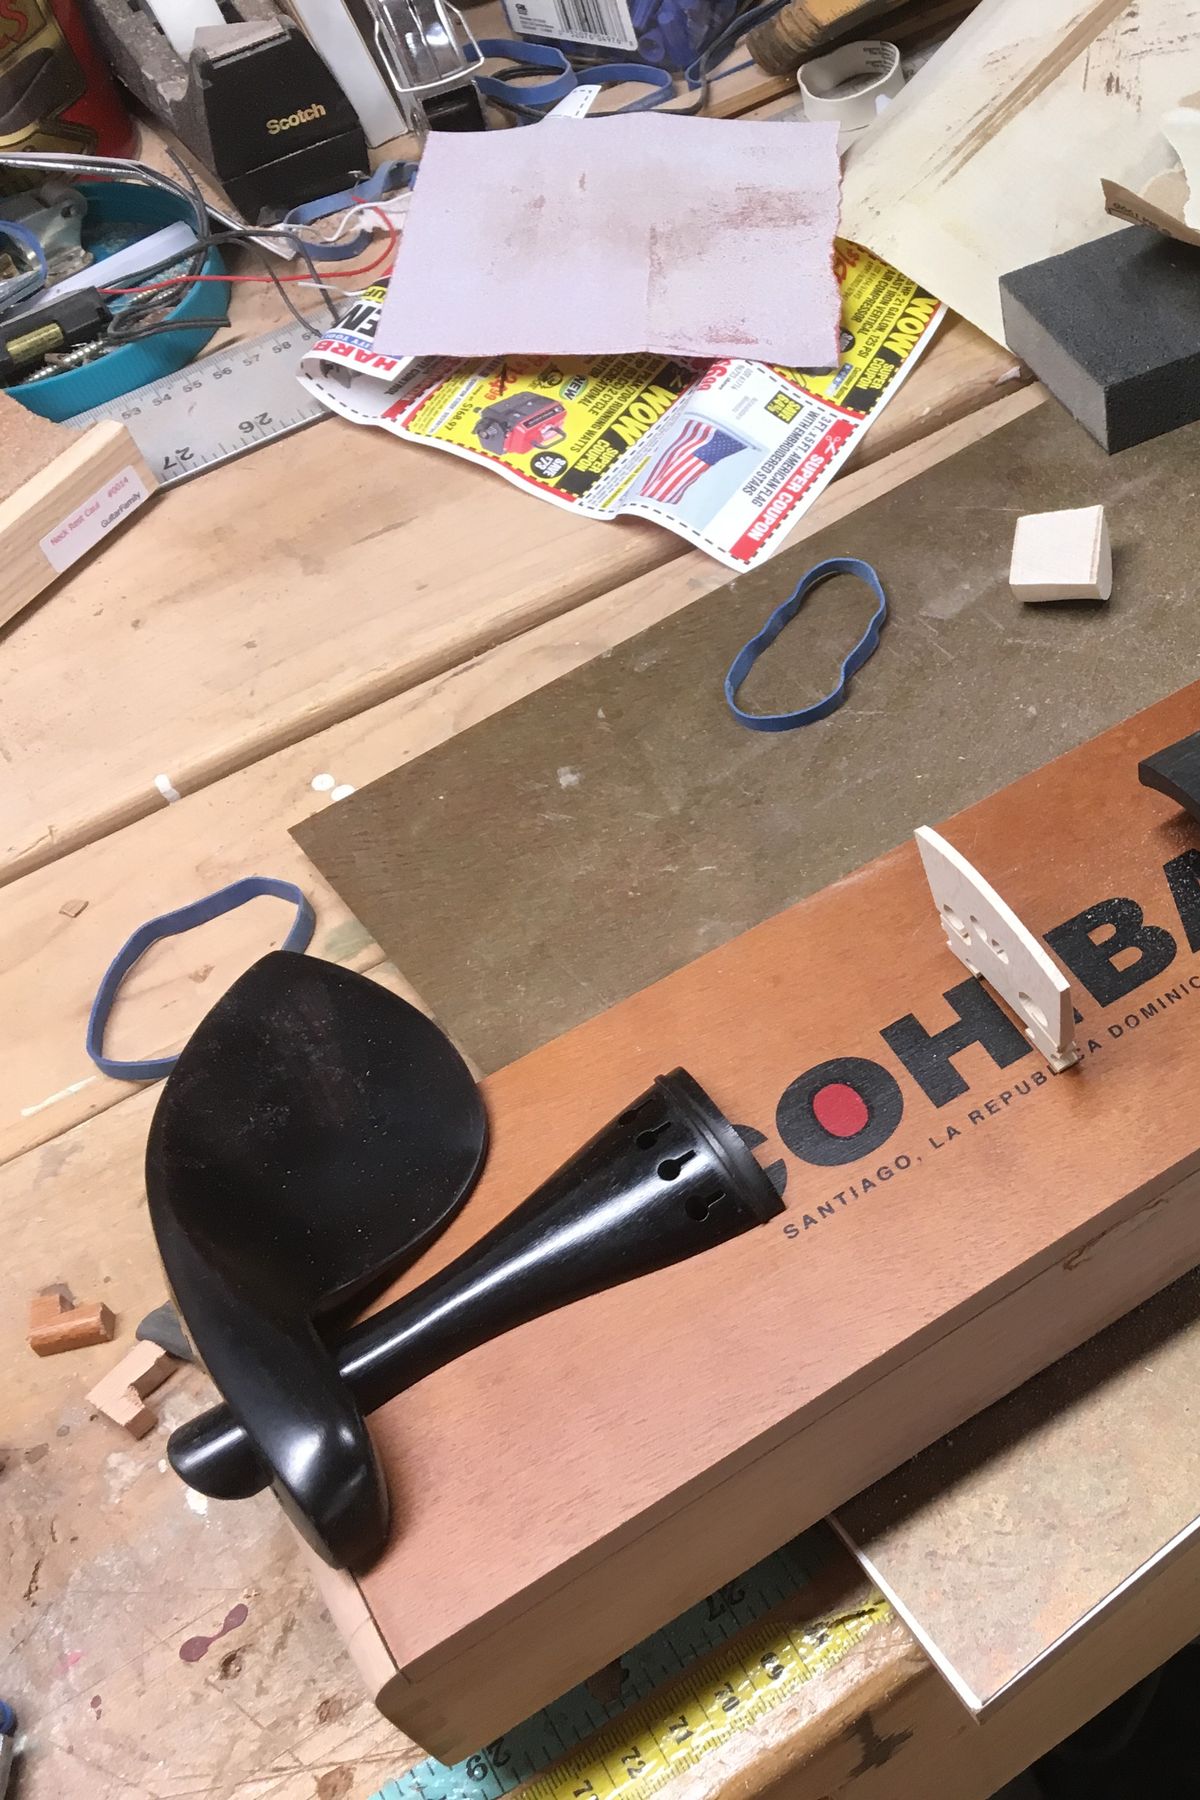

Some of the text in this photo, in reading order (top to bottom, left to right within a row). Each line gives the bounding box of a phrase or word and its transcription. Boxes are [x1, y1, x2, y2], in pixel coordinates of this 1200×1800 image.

[266, 103, 326, 135] Scotch
[851, 269, 896, 323] AIR COMPRESSOR
[879, 290, 895, 306] IRON
[857, 304, 883, 336] VERTICAL
[884, 298, 939, 358] WOW
[857, 345, 872, 359] PSI
[865, 333, 879, 346] 125
[122, 407, 142, 421] 53
[152, 393, 172, 407] 54
[182, 380, 203, 393] 55
[212, 367, 233, 380] 56
[242, 354, 261, 367] 57
[272, 341, 292, 354] 58
[384, 367, 420, 395] CONTROL
[564, 375, 587, 400] NEW
[577, 359, 627, 408] RECREATIONAL
[856, 358, 885, 390] COUPON
[870, 363, 895, 389] SUPER
[445, 402, 473, 430] $168.97
[587, 392, 612, 417] CYCLE
[591, 400, 623, 432] RUNNING
[611, 385, 678, 446] WOW
[779, 403, 801, 424] SAVE
[811, 420, 827, 435] FT.
[820, 416, 830, 425] 3
[163, 412, 273, 471] 27 26
[570, 428, 599, 452] WATTS
[742, 409, 819, 497] WITH EMBROIDERED STARS
[796, 441, 811, 456] FT.
[803, 436, 815, 446] 5
[543, 458, 566, 477] SAVE
[574, 440, 610, 472] COUPON
[590, 447, 619, 473] SUPER
[768, 451, 802, 487] AMERICAN
[747, 454, 824, 541] SUPER COUPON
[751, 484, 772, 508] FLAG
[50, 530, 69, 546] Neck
[68, 515, 85, 530] Rest
[783, 1151, 923, 1241] SANTIAGO,
[928, 1124, 963, 1151] LA
[621, 1745, 647, 1780] 72
[573, 1779, 600, 1800] 7
